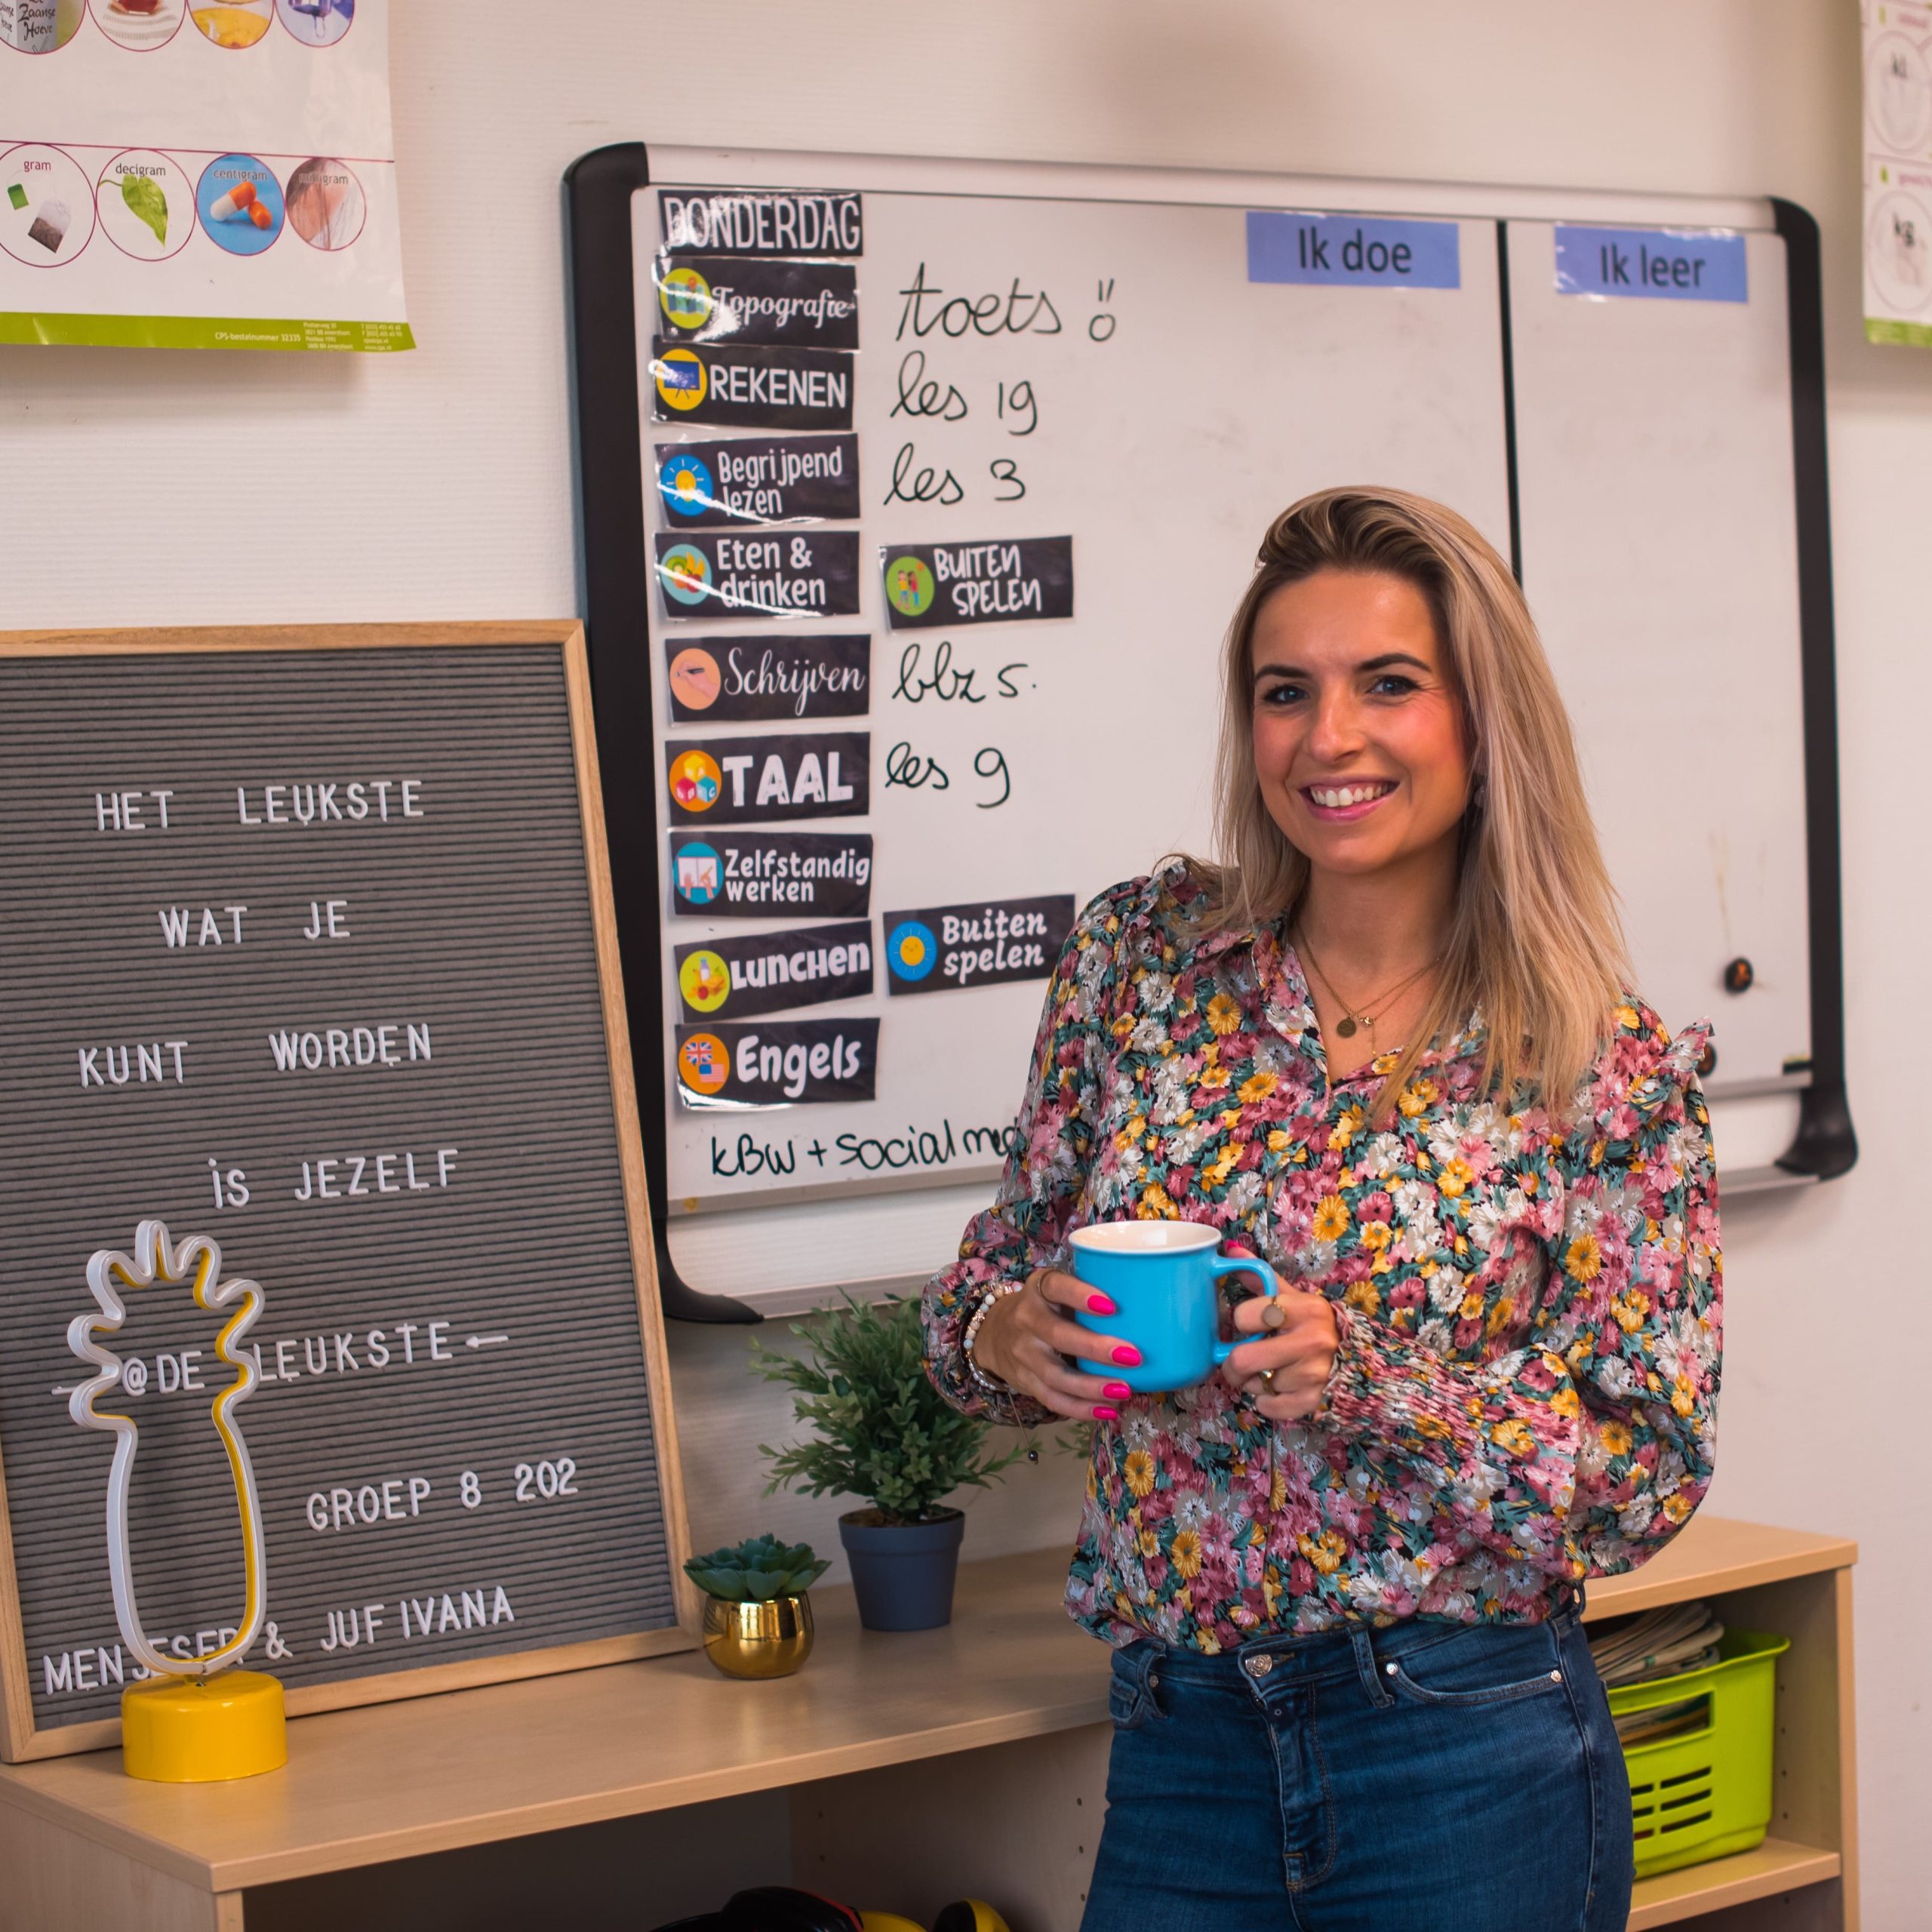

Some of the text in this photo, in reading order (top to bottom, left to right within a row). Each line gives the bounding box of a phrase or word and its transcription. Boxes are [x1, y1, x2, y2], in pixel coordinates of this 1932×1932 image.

[18, 4, 55, 23] Zaanse
[23, 160, 51, 172] gram
[115, 163, 166, 177] decigram
[213, 169, 267, 181] centigram
[663, 196, 860, 250] DONDERDAG
[1298, 226, 1411, 274] Ik doe
[1600, 243, 1706, 288] Ik leer
[712, 285, 856, 328] Topografie
[896, 261, 1062, 342] toets
[709, 365, 846, 408] REKENEN
[890, 349, 1038, 435] les 19
[718, 445, 842, 489] Begrijpend
[883, 441, 1026, 506] les 3
[722, 487, 783, 517] lezen
[717, 537, 813, 571] Eten &
[720, 571, 826, 608] drinken
[724, 647, 866, 716] Schrijven
[722, 752, 854, 807] TAAL
[884, 741, 1011, 809] les 9
[95, 780, 424, 831] HET LEUKSTE
[724, 848, 870, 886] Zelfstandig
[724, 874, 814, 902] werken
[158, 900, 350, 948] WAT JE
[942, 908, 1048, 945] Buiten
[943, 940, 1044, 985] spelen
[78, 1023, 432, 1088] KUNT WORDEN
[736, 1035, 862, 1098] Engels
[294, 1148, 459, 1201] JEZELF
[807, 1140, 828, 1167] +
[253, 1321, 453, 1383] LEUKSTE
[306, 1457, 579, 1532] GROEP 8 202
[265, 1621, 294, 1660] &
[320, 1603, 386, 1654] JUF
[399, 1586, 515, 1640] IVANA
